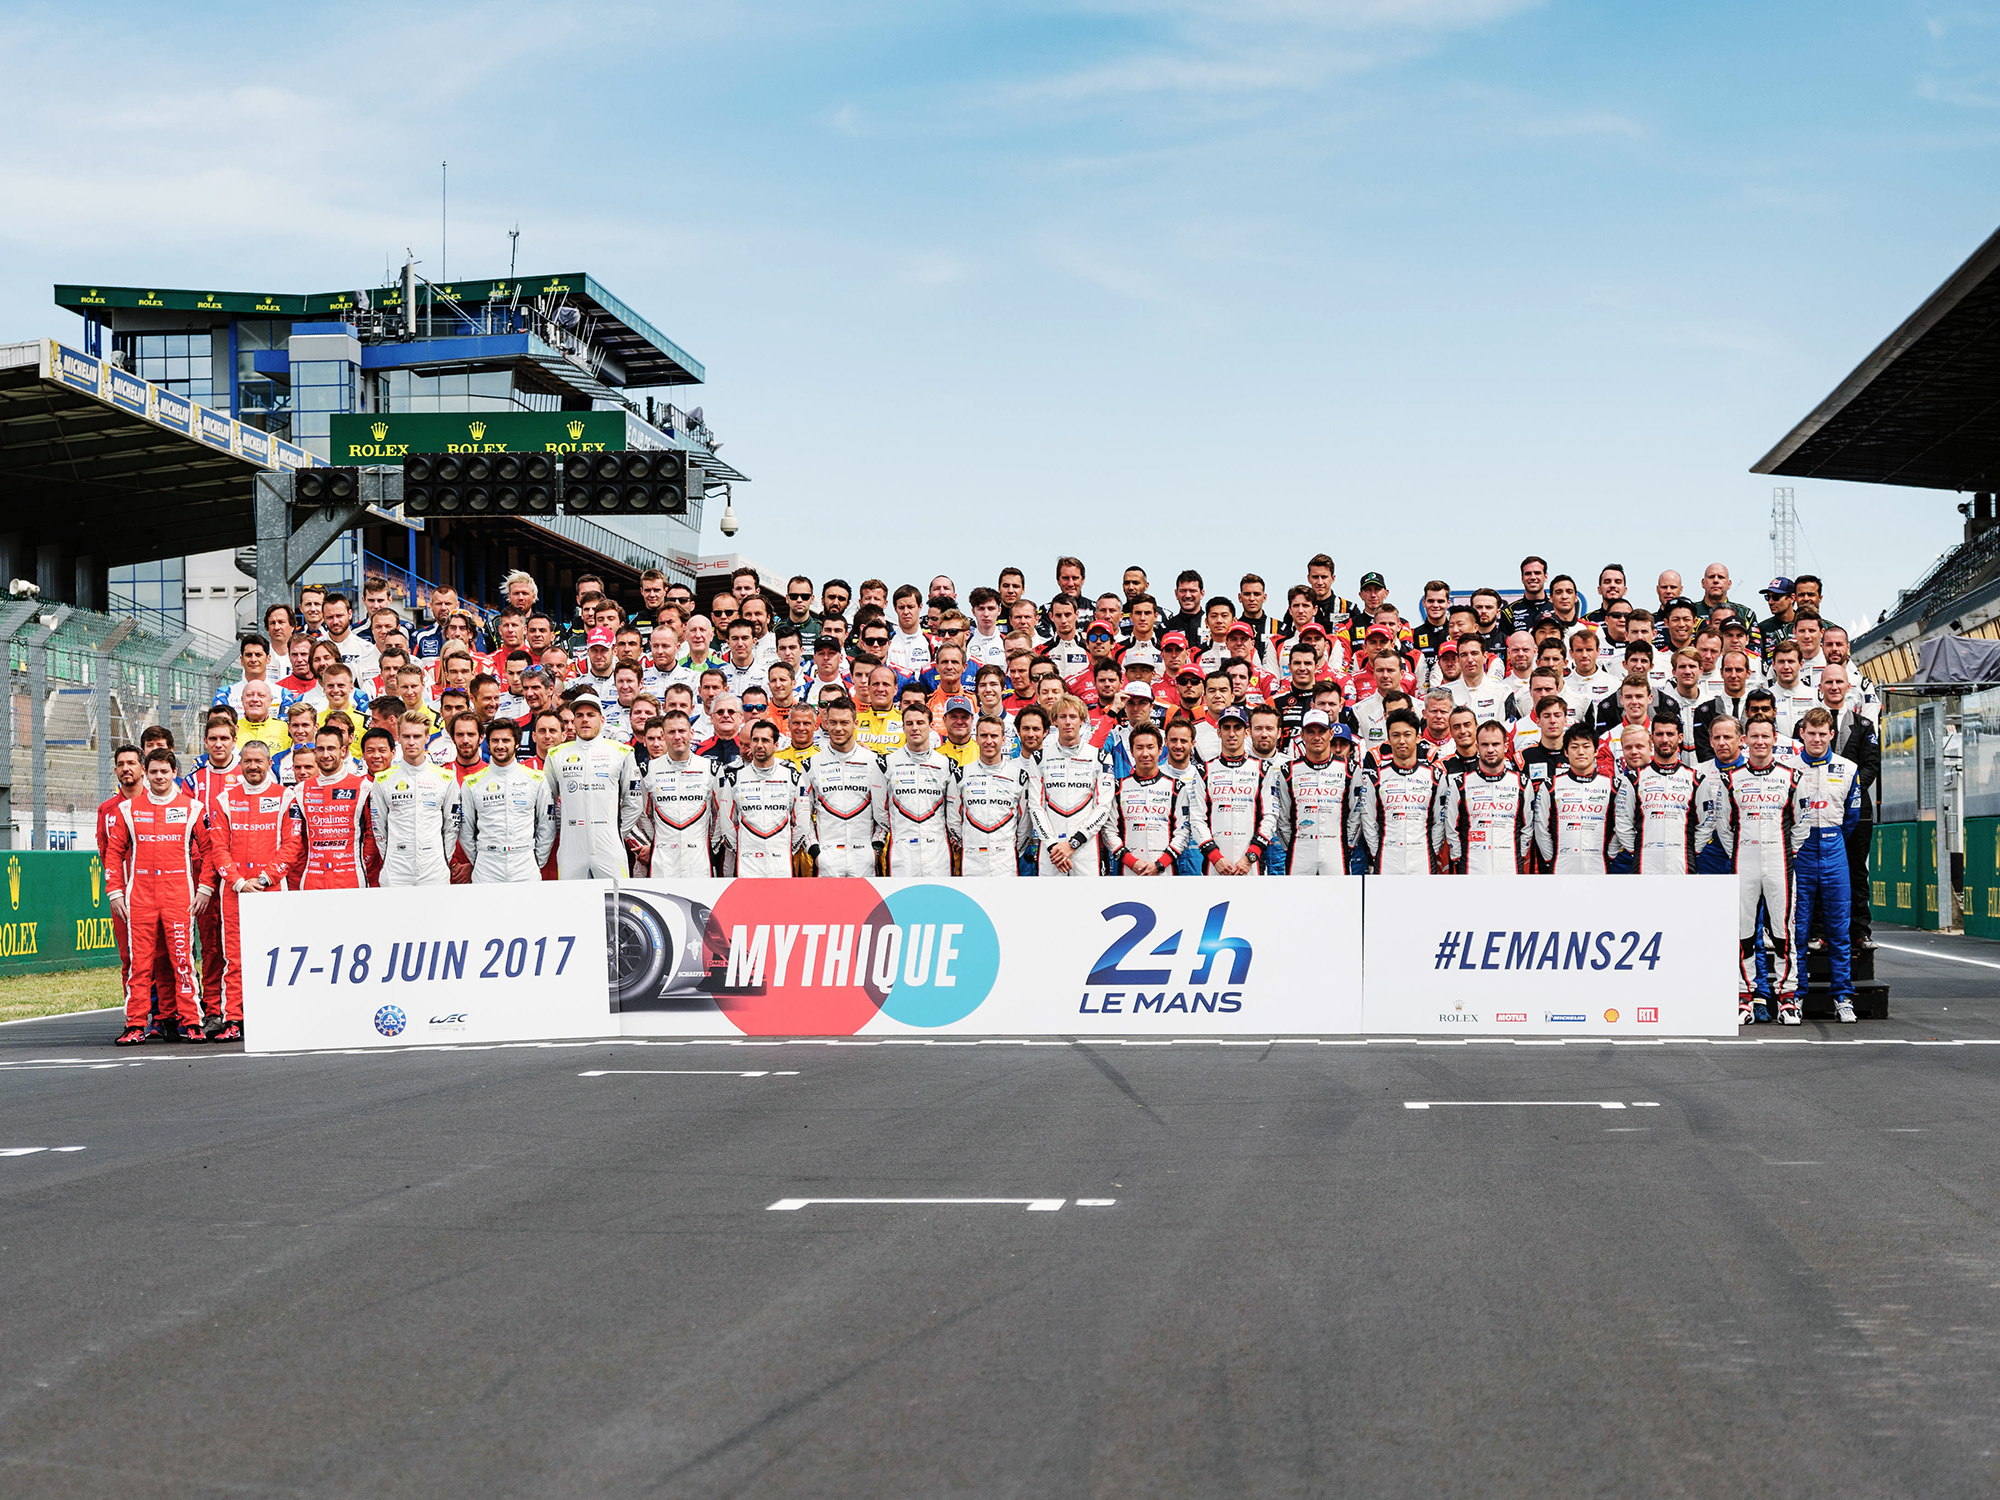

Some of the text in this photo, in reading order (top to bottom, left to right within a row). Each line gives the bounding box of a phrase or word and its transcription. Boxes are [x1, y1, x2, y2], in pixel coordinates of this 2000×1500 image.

[81, 296, 106, 304] ROLEX
[138, 299, 164, 307] ROLEX
[197, 302, 223, 310] ROLEX
[255, 304, 281, 312] ROLEX
[63, 354, 98, 383] MICHELIN
[113, 376, 147, 405] MICHELIN
[160, 397, 190, 423] MICHELIN
[203, 416, 230, 440] MICHELIN
[242, 432, 268, 455] MICHELIN
[447, 443, 508, 453] ROLEX
[545, 442, 606, 452] ROLEX
[349, 444, 409, 457] ROLEX
[856, 732, 900, 744] JUMBO
[918, 788, 941, 796] MORI
[1212, 786, 1252, 795] DENSO
[1298, 788, 1338, 796] DENSO
[1386, 794, 1426, 804] DENSO
[1644, 792, 1686, 802] DENSO
[1741, 794, 1781, 803] DENSO
[989, 799, 1012, 807] MORI
[1472, 802, 1514, 811] DENSO
[324, 804, 350, 813] SPORT
[1126, 806, 1166, 814] DENSO
[1562, 804, 1603, 814] DENSO
[250, 822, 276, 830] SPORT
[156, 834, 182, 842] SPORT
[1471, 832, 1486, 840] Plus
[76, 918, 116, 951] ROLEX
[174, 921, 187, 964] SPORT
[1085, 900, 1253, 986] 24h
[1434, 931, 1664, 970] #LEMANS24
[266, 936, 576, 987] 17-18 JUIN 2017
[724, 923, 964, 994] MYTHIQUE
[1079, 992, 1243, 1014] LE MANS
[1439, 1014, 1479, 1022] ROLEX
[1497, 1014, 1526, 1022] MOTUL
[1638, 1009, 1658, 1021] RTL
